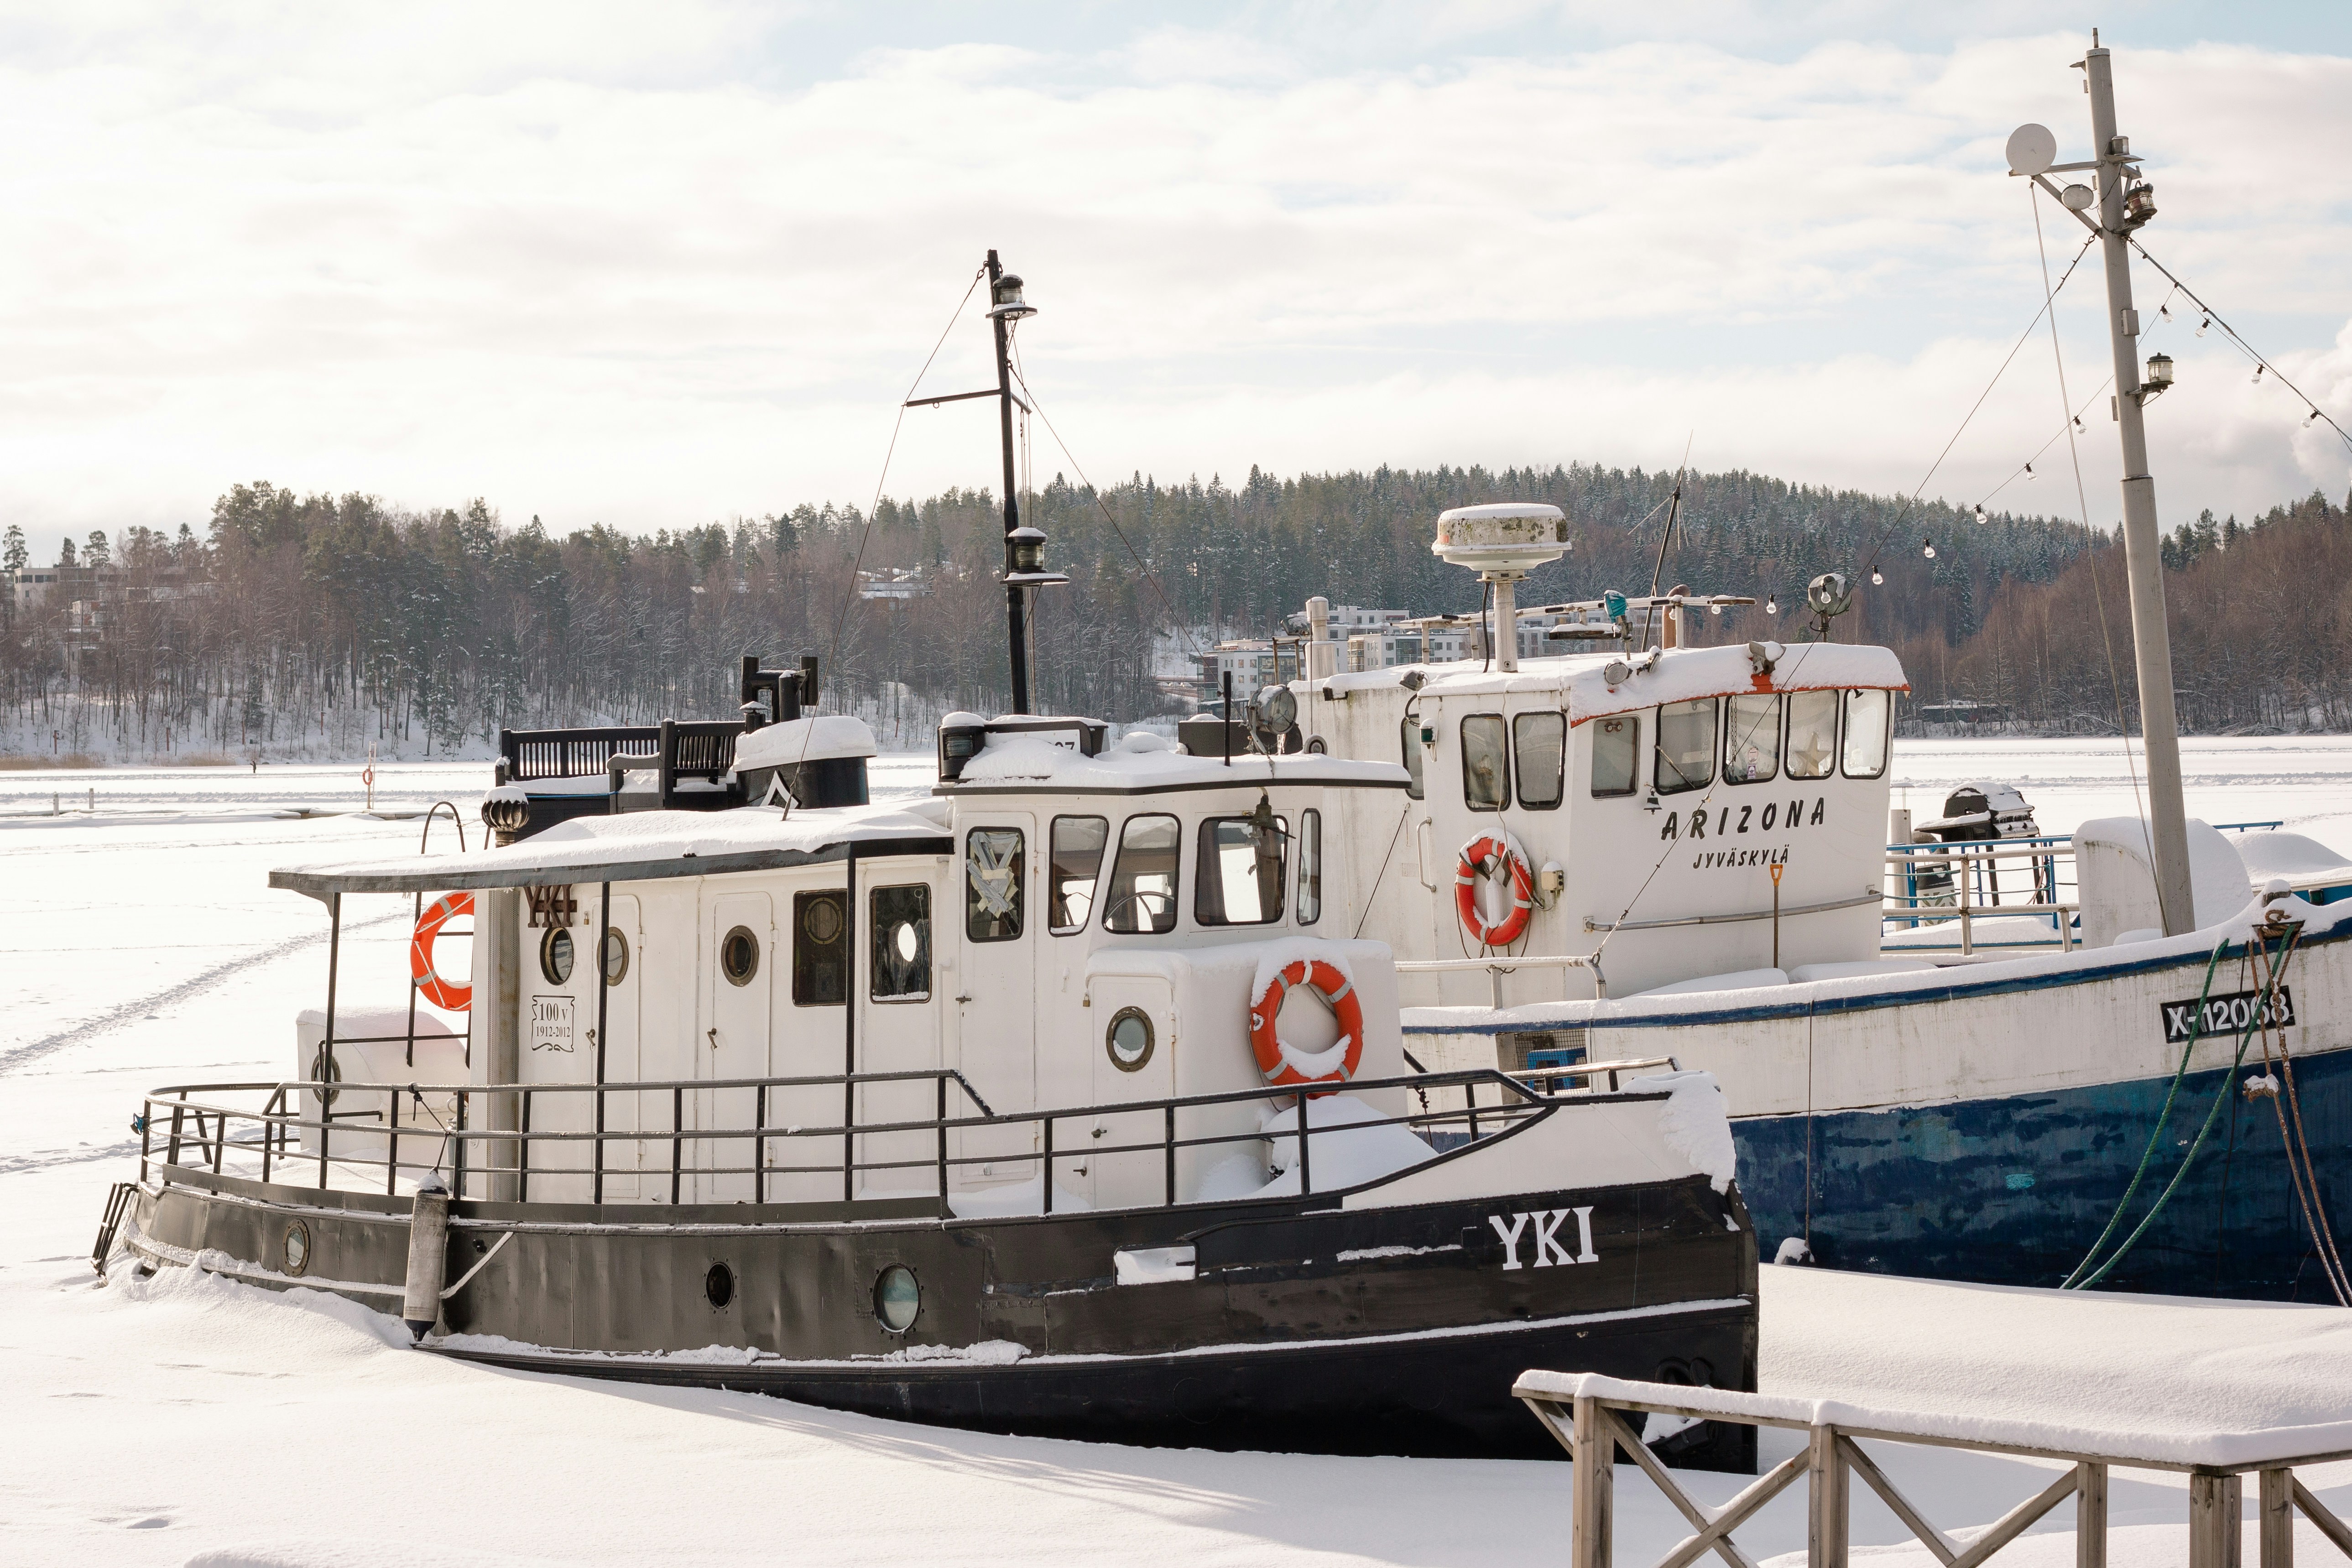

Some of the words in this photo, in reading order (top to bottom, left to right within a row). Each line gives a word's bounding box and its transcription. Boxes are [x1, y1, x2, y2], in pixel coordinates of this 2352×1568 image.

[1661, 797, 1824, 840] ARIZONA
[1693, 844, 1789, 869] JYVÄSKYLÄ
[524, 884, 573, 927] YKI
[539, 1003, 559, 1021] 100
[536, 1026, 570, 1038] 1912-2012
[1489, 1206, 1599, 1270] YKI
